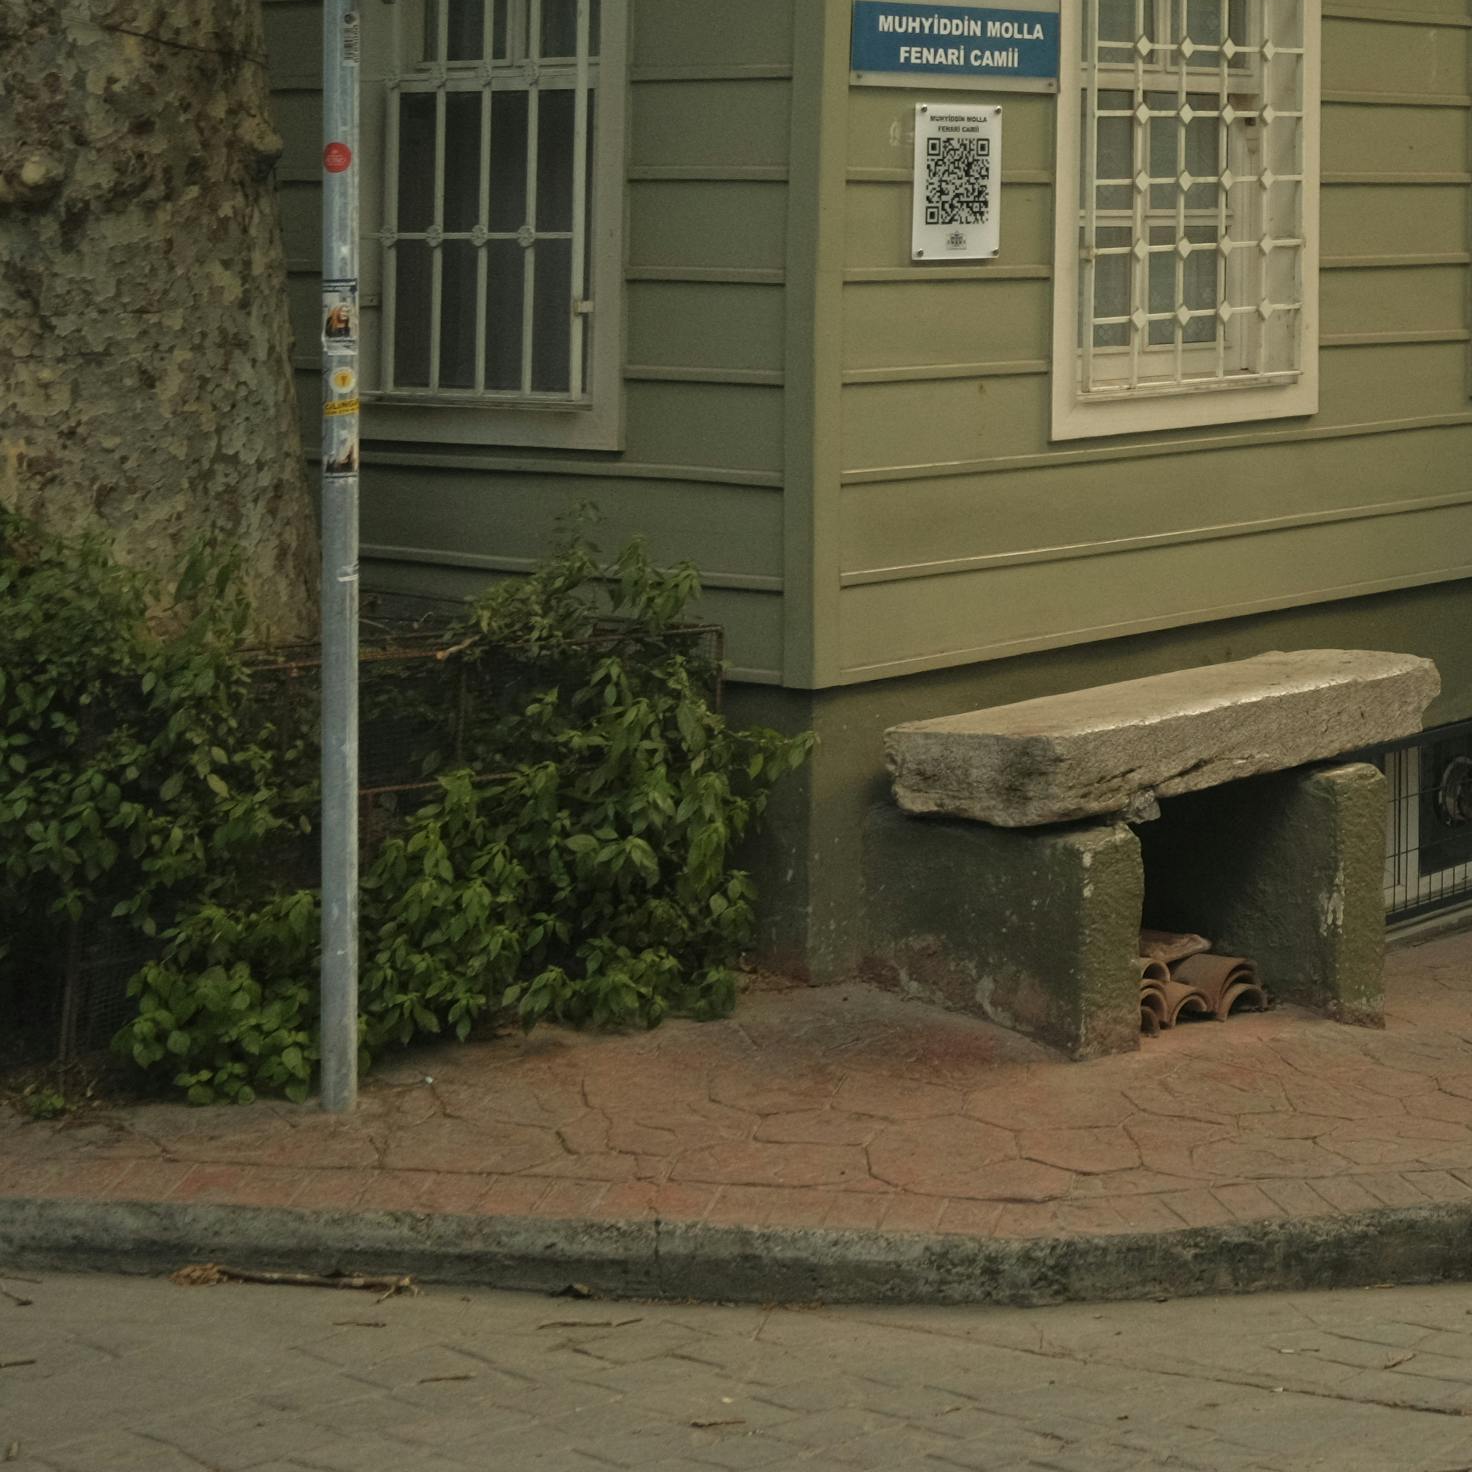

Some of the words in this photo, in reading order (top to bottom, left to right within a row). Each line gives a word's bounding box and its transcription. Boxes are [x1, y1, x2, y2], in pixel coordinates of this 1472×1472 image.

[879, 14, 982, 37] MUHYİDDİN
[986, 21, 1044, 41] MOLLA
[899, 45, 965, 66] FENARİ
[970, 47, 1019, 68] CAMİİ
